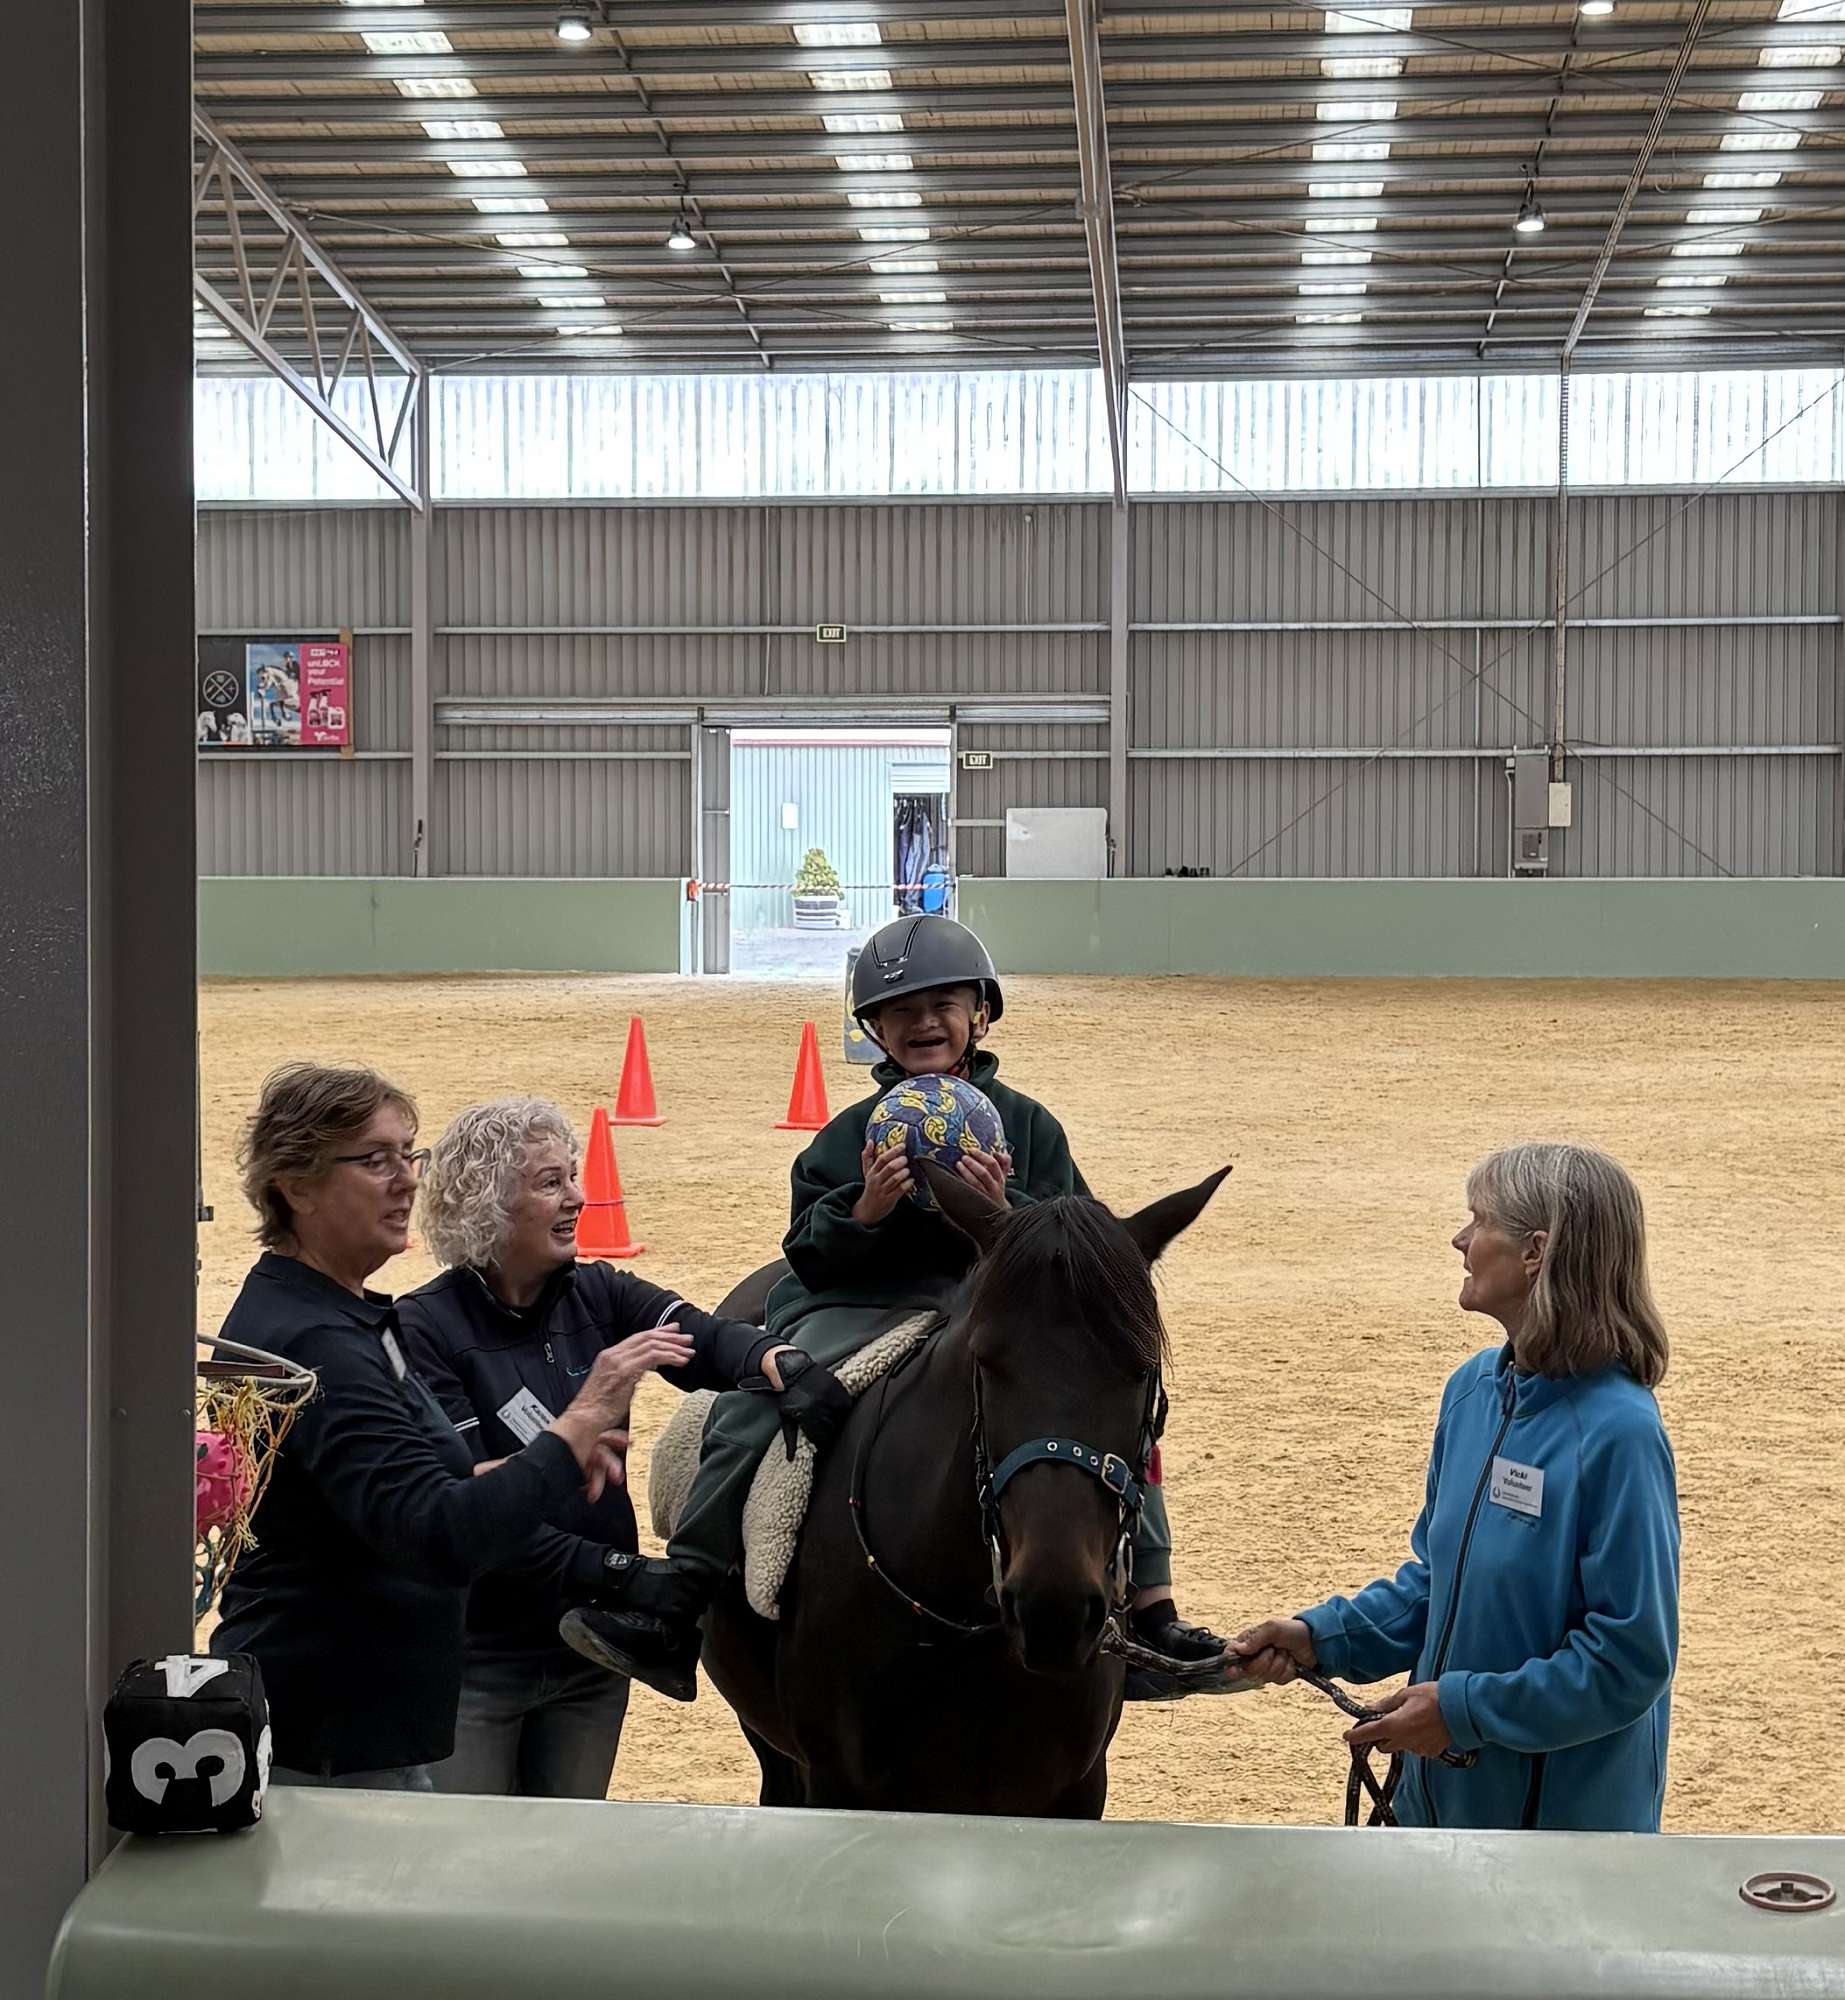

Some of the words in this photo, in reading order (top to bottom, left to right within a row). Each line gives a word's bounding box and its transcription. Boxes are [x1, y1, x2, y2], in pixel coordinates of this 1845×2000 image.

[822, 627, 841, 639] EXIT
[969, 754, 987, 766] EXIT
[1503, 1476, 1533, 1492] Volunteer
[131, 1728, 246, 1808] 3
